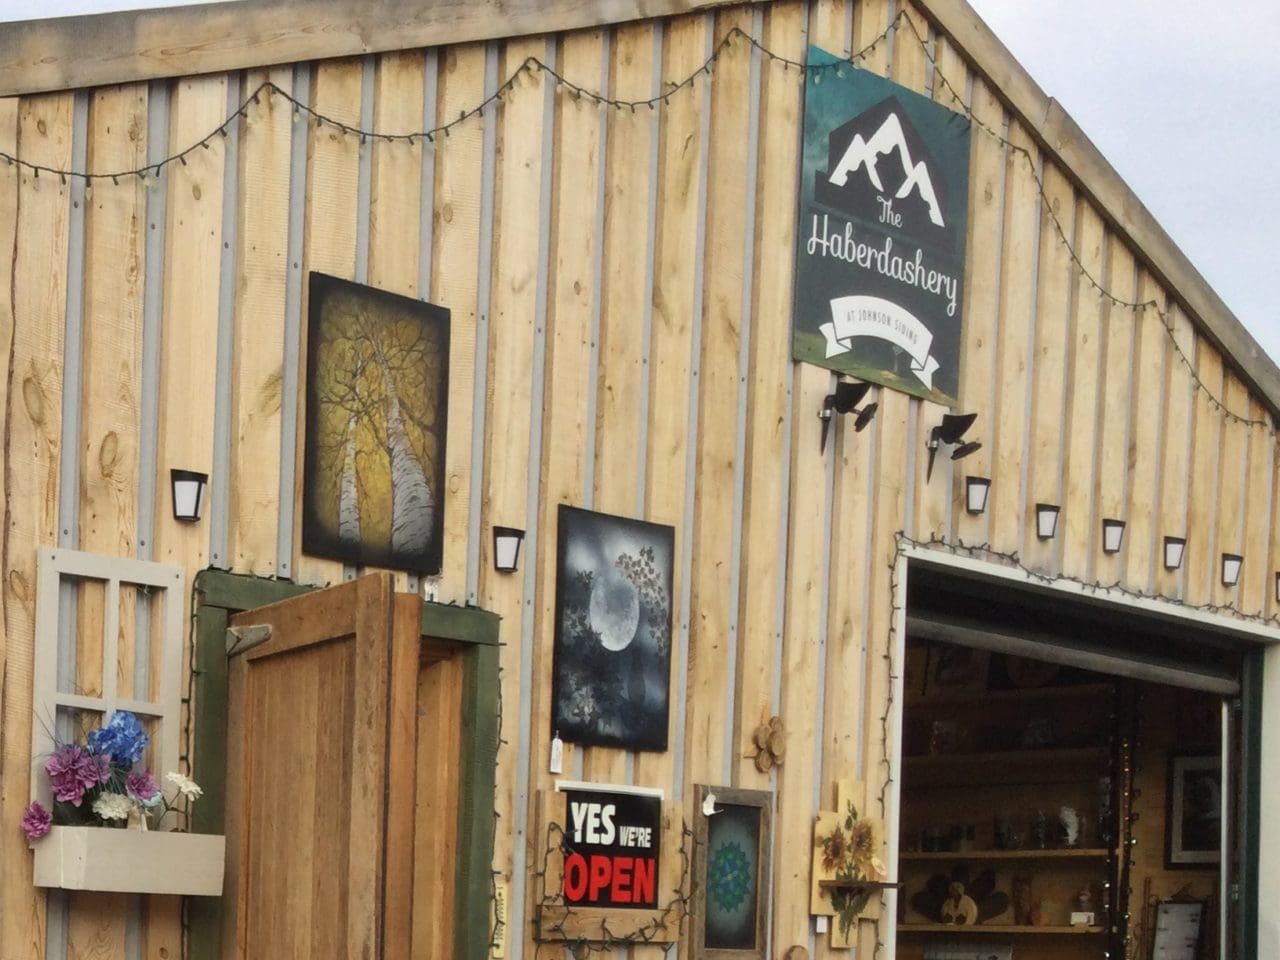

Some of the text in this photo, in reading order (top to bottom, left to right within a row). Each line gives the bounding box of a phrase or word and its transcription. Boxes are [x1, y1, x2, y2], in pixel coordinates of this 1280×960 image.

[877, 195, 903, 228] The
[807, 214, 957, 317] Haberdashery
[847, 309, 918, 345] AT JOHNSON SIDING
[571, 802, 652, 848] YES WE'RE
[564, 852, 656, 904] OPEN
